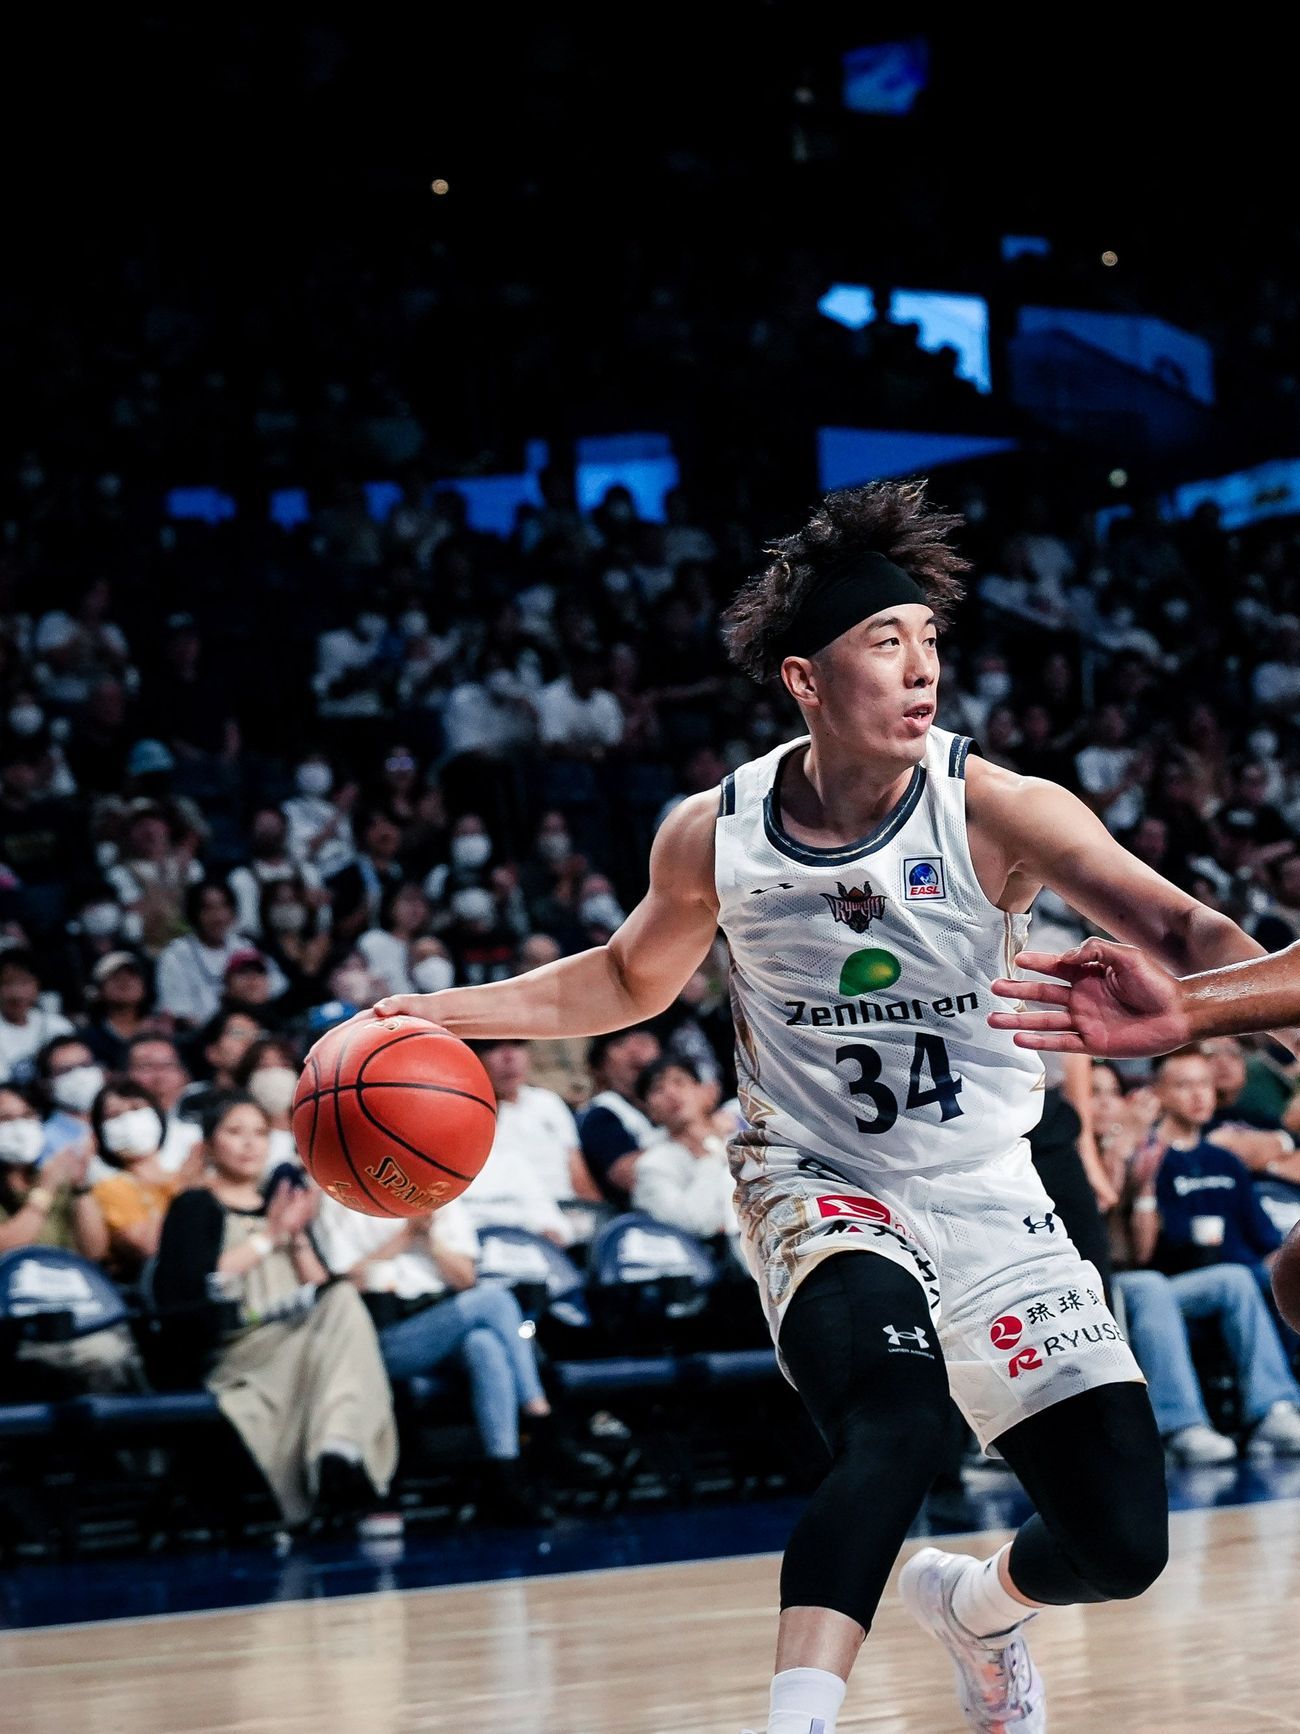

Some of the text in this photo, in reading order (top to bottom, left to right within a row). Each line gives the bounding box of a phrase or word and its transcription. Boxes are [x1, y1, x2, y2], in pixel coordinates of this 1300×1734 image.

[909, 886, 941, 896] EASL
[785, 992, 979, 1027] Zenhoren
[835, 1032, 965, 1134] 34
